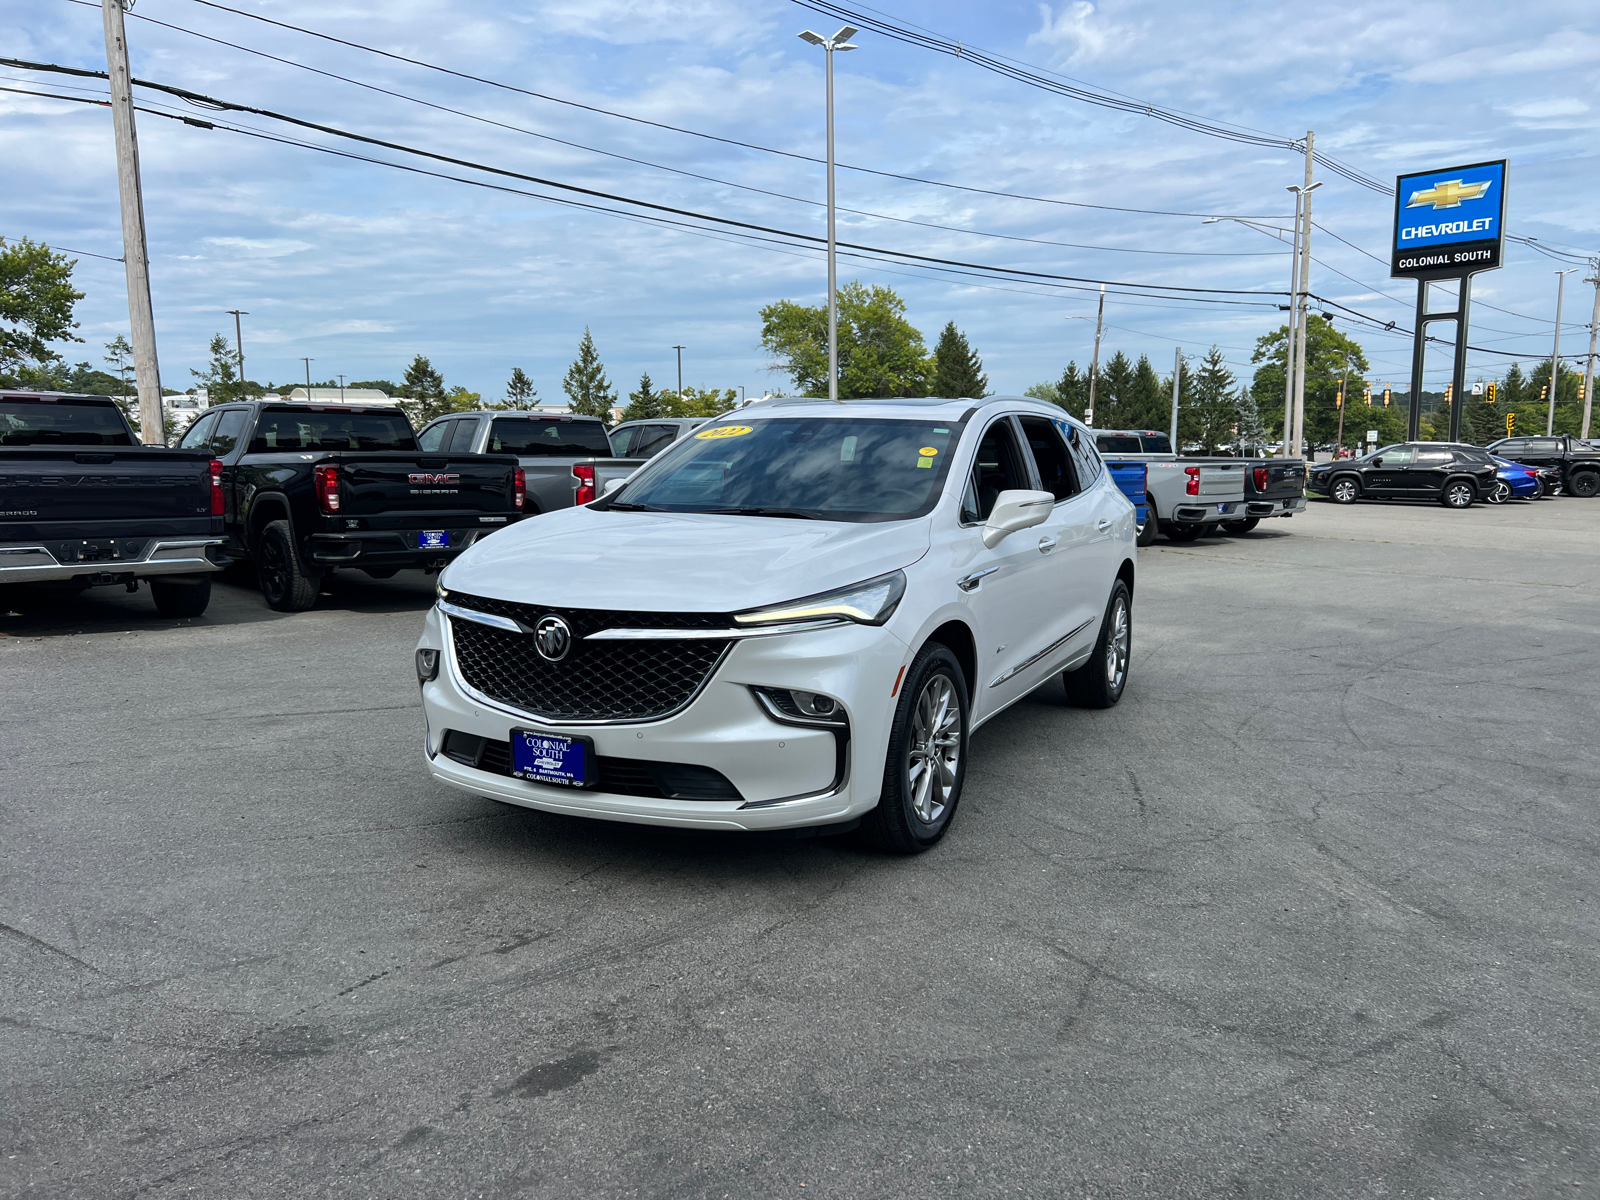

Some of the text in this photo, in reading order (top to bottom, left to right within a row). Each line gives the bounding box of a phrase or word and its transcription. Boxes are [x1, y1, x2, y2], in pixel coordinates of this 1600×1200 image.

[1401, 217, 1493, 240] CHEVROLET
[1399, 249, 1491, 269] COLONIAL SOUTH
[0, 476, 199, 487] HEVROLET
[408, 473, 460, 485] GMC
[526, 737, 570, 752] COLONIAL
[532, 748, 563, 760] SOUTH
[536, 759, 560, 767] CHEVROLET
